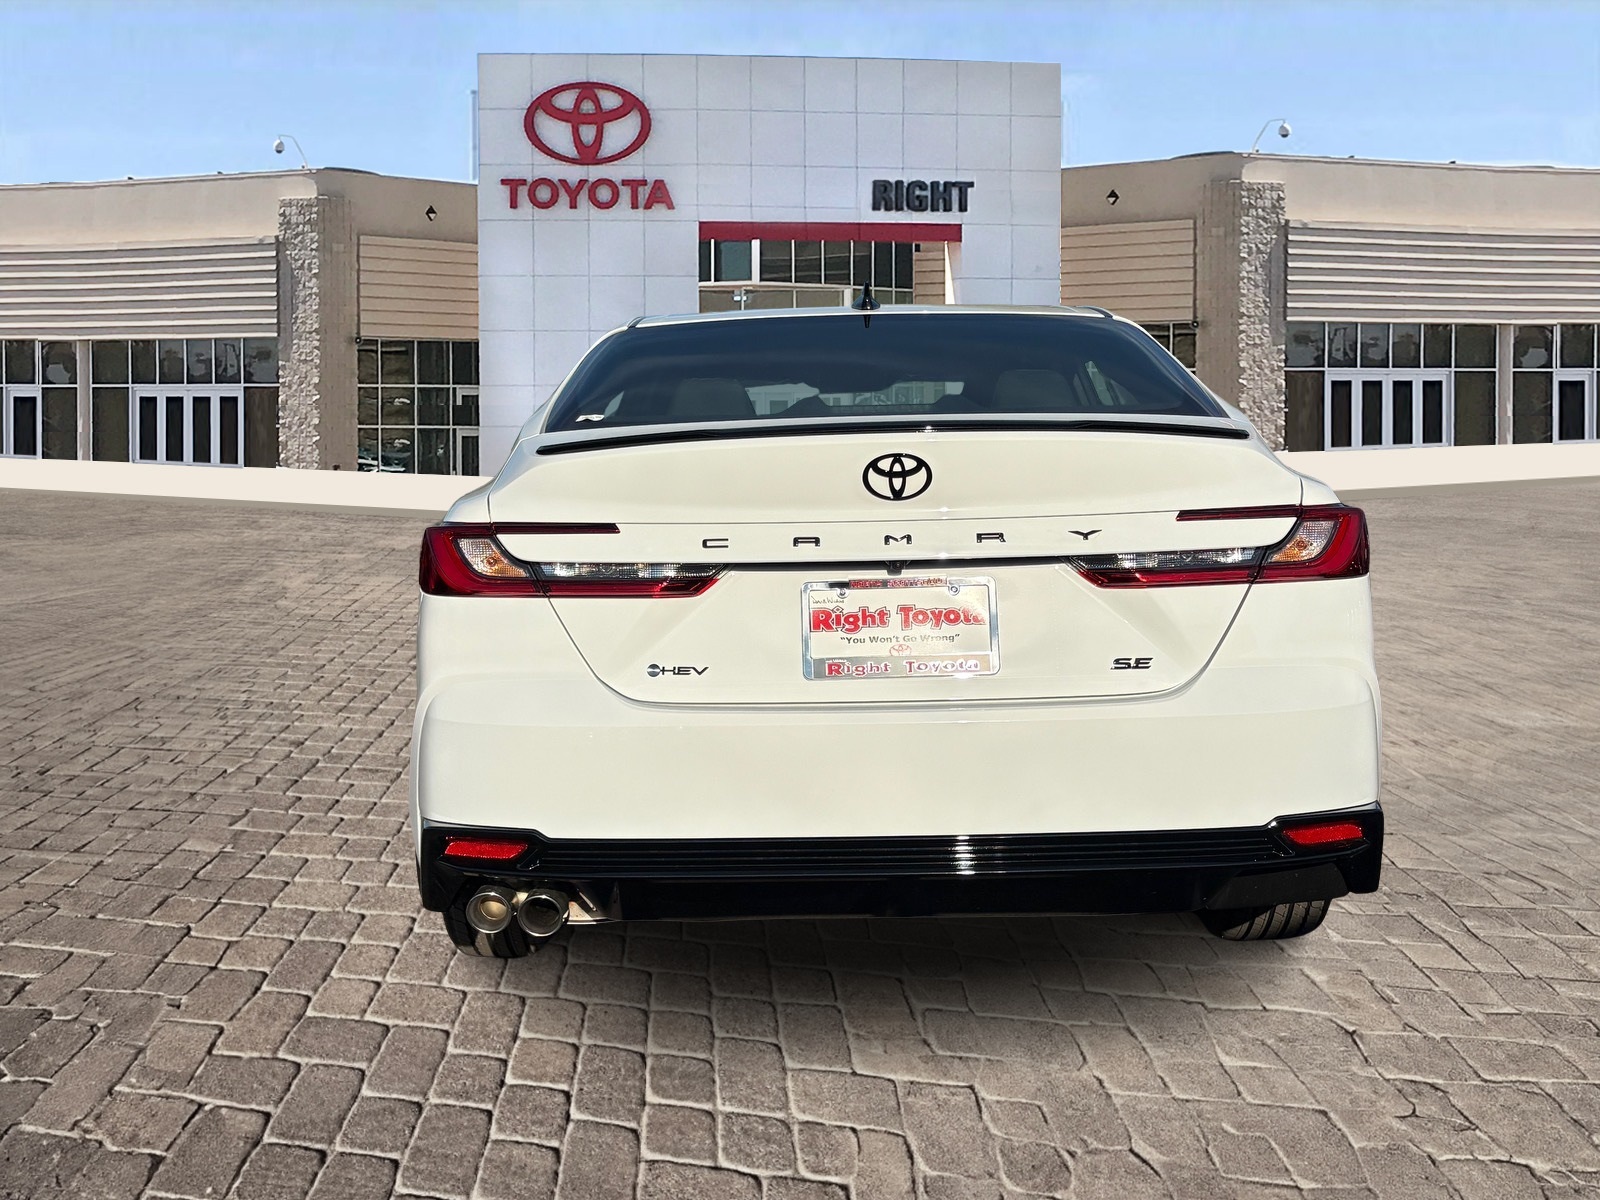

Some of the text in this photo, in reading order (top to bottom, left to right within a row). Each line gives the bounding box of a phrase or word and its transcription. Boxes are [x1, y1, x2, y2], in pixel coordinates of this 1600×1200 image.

[500, 178, 675, 211] TOYOTA
[871, 179, 975, 213] RIGHT
[702, 529, 1102, 549] CAMRY
[811, 604, 986, 634] Right Toyota
[660, 666, 709, 676] HEV
[825, 658, 980, 677] Right Toyota
[1110, 657, 1154, 670] SE
